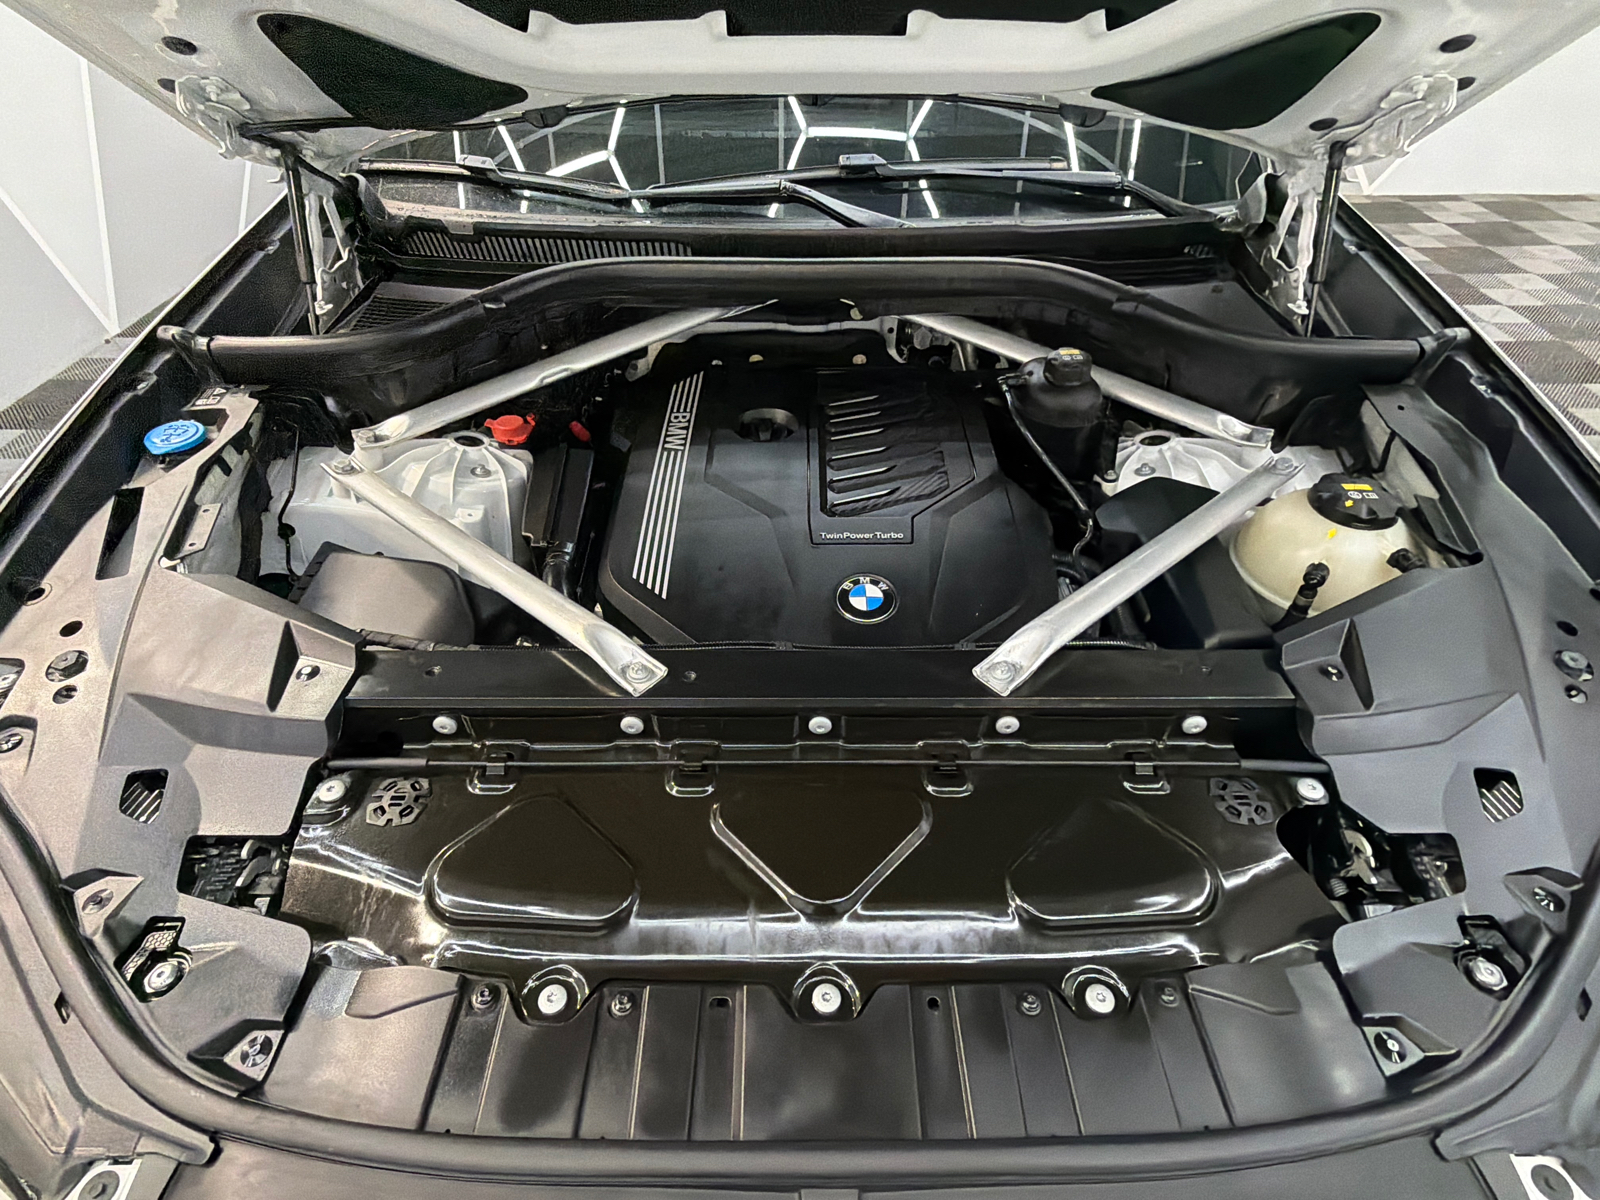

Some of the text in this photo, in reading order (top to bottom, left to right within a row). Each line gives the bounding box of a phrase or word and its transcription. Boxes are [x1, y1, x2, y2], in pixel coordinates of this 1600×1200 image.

[664, 412, 691, 450] BMW
[875, 531, 904, 539] Turbo
[842, 576, 889, 590] BMW
